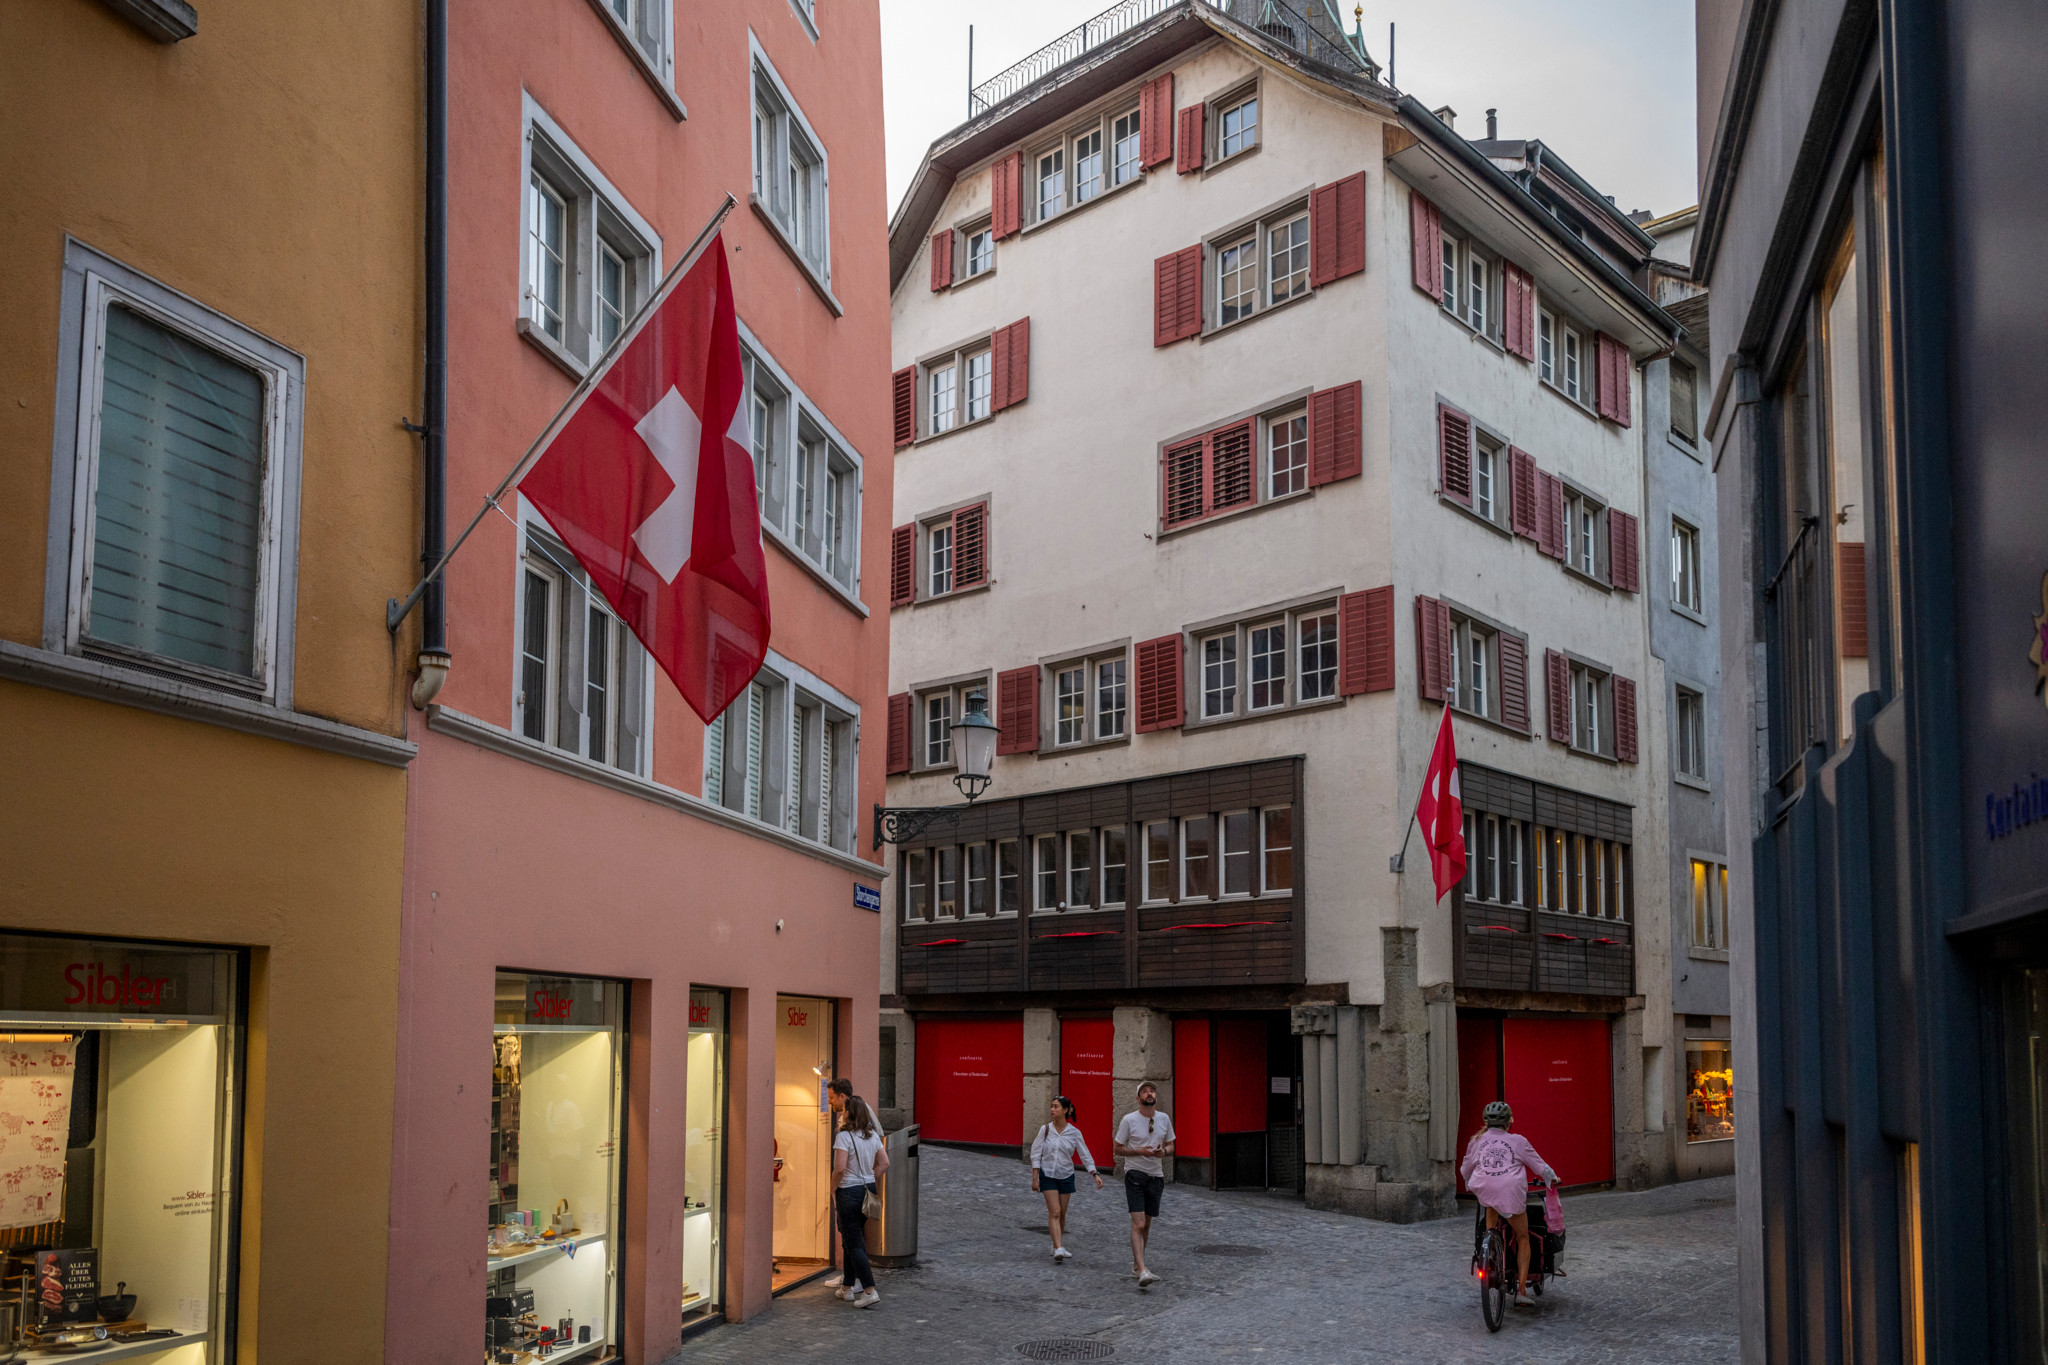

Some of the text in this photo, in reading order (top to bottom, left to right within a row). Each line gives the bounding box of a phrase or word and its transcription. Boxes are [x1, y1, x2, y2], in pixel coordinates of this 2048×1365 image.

[64, 962, 169, 1006] Sibler
[533, 990, 573, 1018] Sibler
[689, 999, 711, 1024] ibler
[787, 1006, 808, 1027] Sibler
[1485, 1168, 1509, 1177] PIZZA
[71, 1268, 89, 1276] ÜBER
[65, 1281, 95, 1290] FLEISCH
